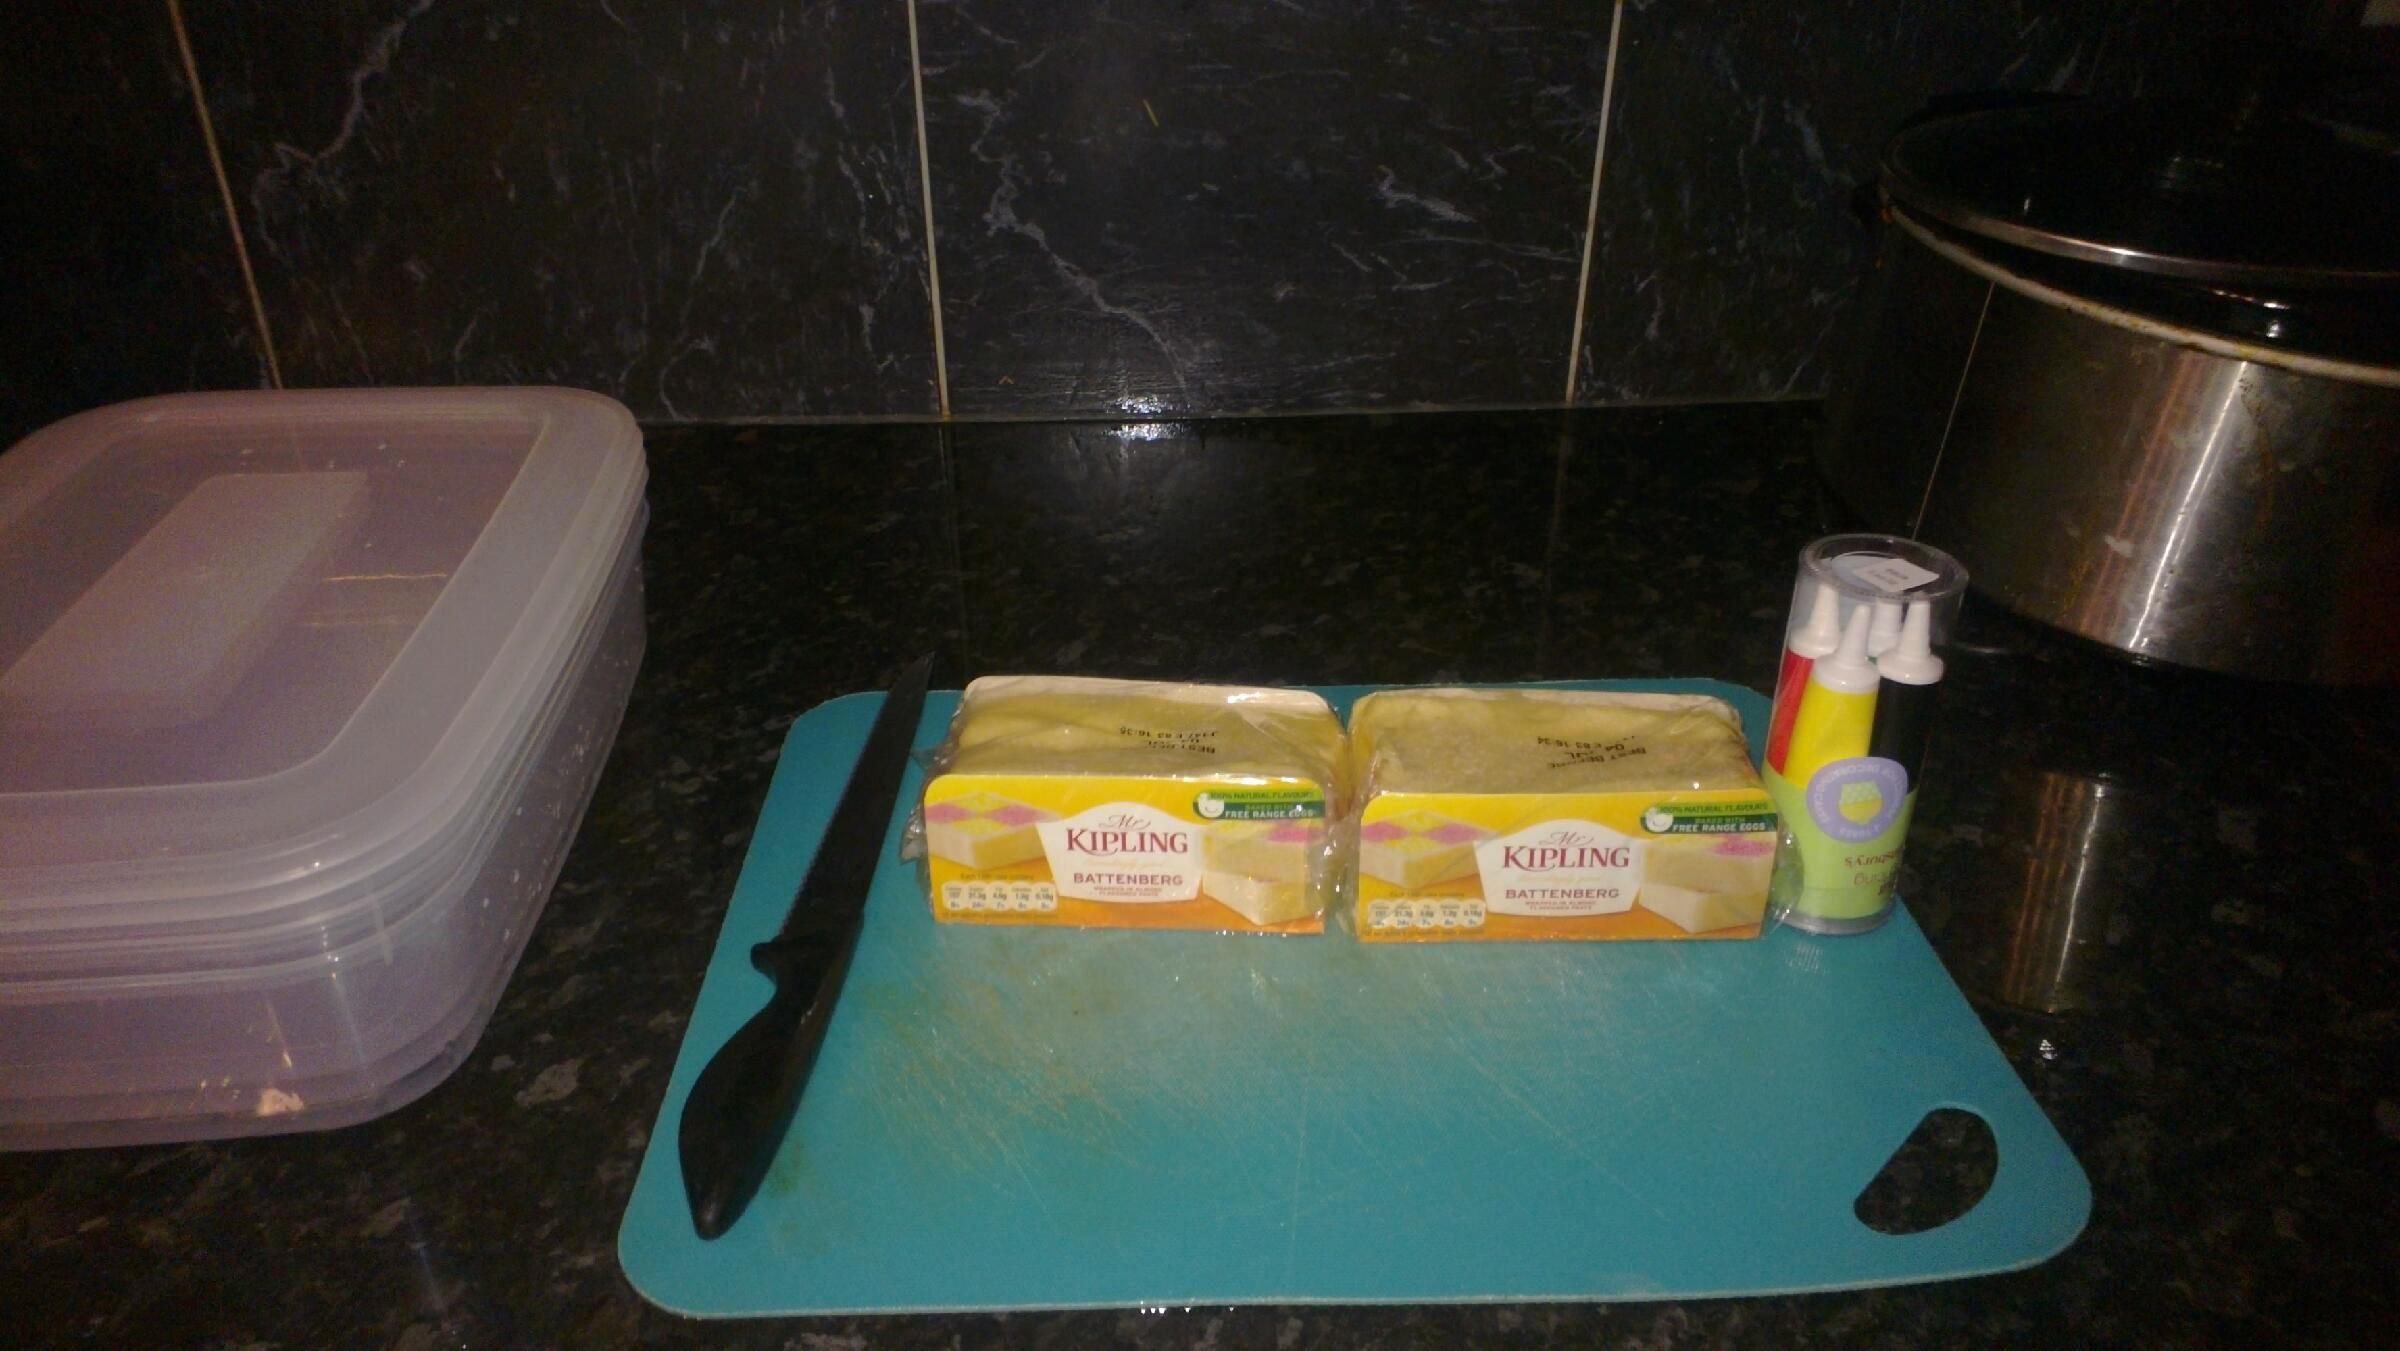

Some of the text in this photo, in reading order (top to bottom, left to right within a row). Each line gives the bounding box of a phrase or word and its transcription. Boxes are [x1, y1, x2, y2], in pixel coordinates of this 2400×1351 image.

[1234, 792, 1270, 800] NATURAL
[1225, 810, 1250, 819] FREE
[1252, 810, 1286, 819] RANGE
[1672, 822, 1766, 833] FREE RANGE EGGS
[1066, 827, 1189, 857] KIPLING
[1502, 845, 1631, 873] KIPLING
[1073, 872, 1184, 886] BATTENBERG
[1505, 888, 1620, 899] BATTENBERG
